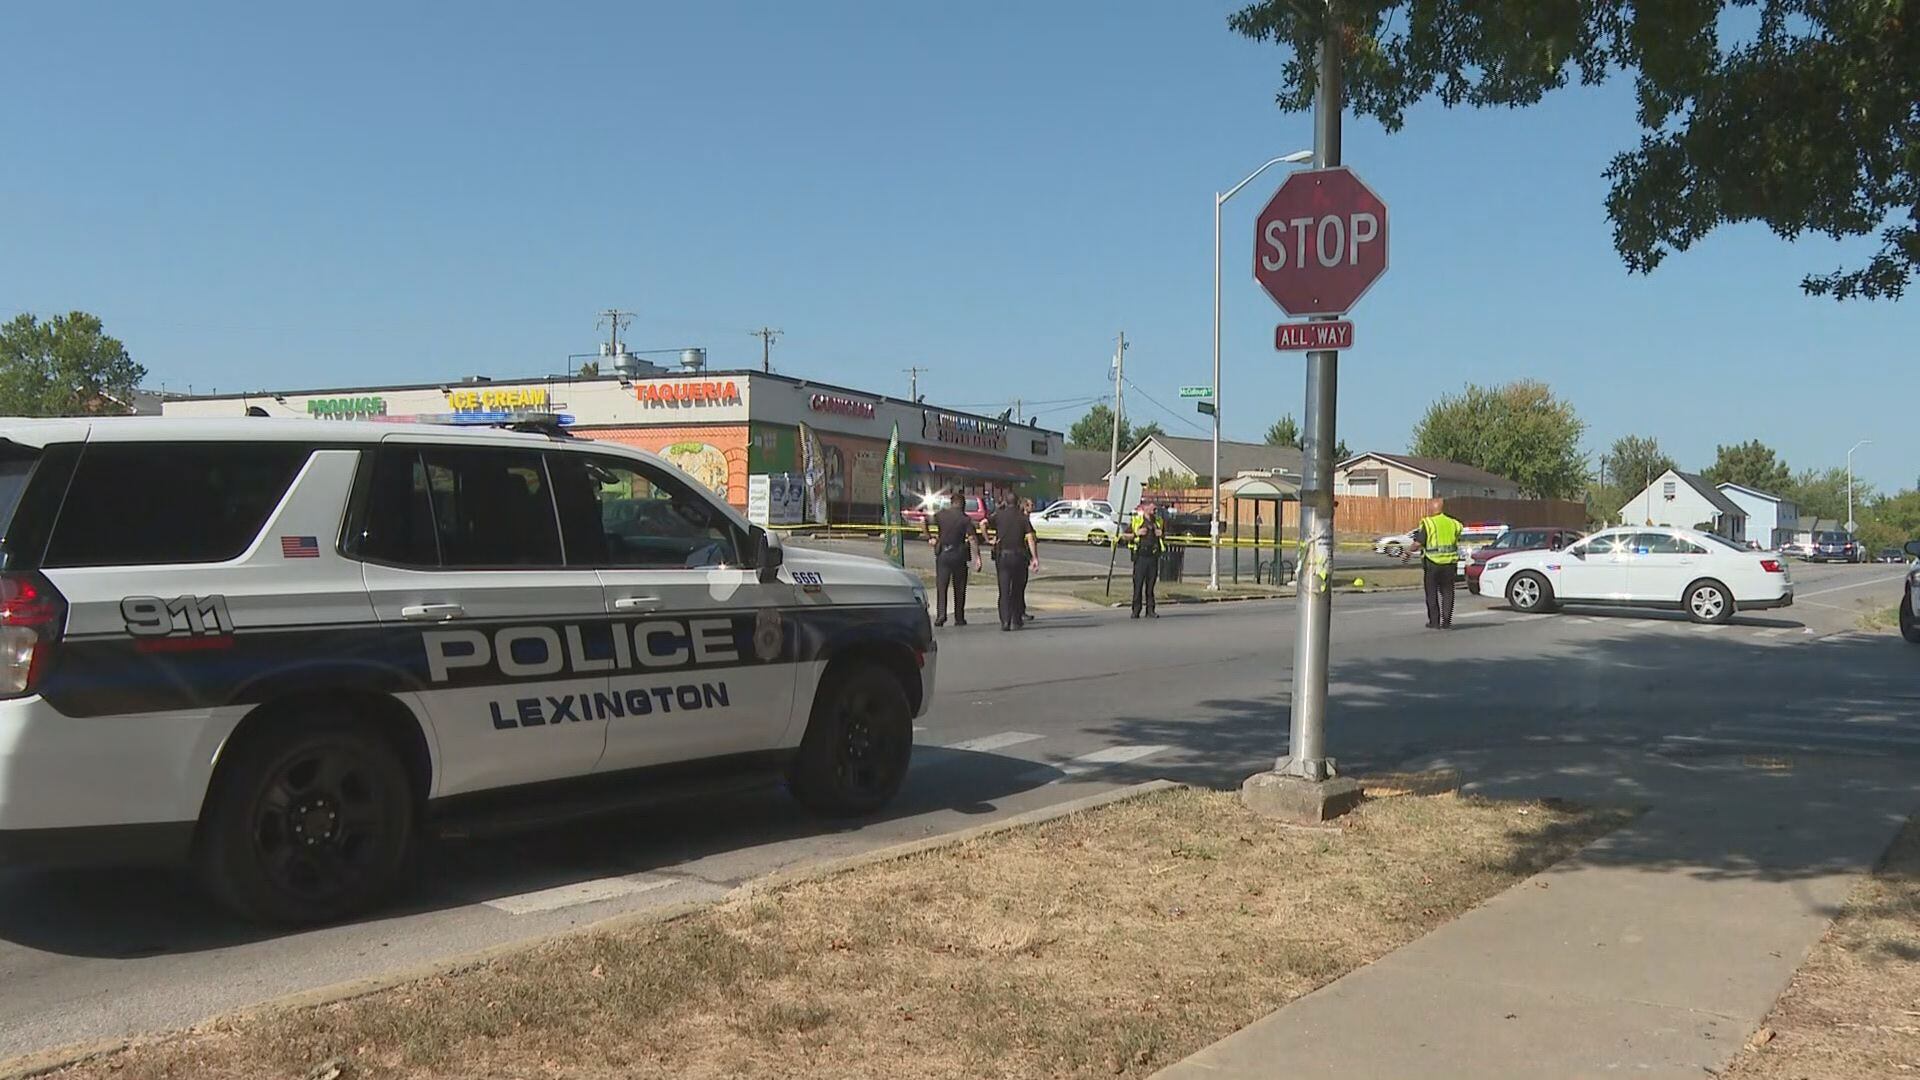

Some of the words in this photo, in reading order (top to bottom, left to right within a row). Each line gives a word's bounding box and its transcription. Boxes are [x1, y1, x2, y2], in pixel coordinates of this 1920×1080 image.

[1262, 212, 1378, 272] STOP
[1281, 328, 1308, 346] ALL
[1316, 326, 1348, 345] WAY
[448, 391, 478, 409] ICE
[482, 388, 546, 408] CREAM
[634, 381, 738, 401] TAQUERIA
[307, 396, 383, 415] PRODUCE
[792, 572, 823, 584] 6667
[120, 594, 234, 636] 911
[422, 618, 739, 682] POLICE
[489, 681, 730, 730] LEXINGTON
